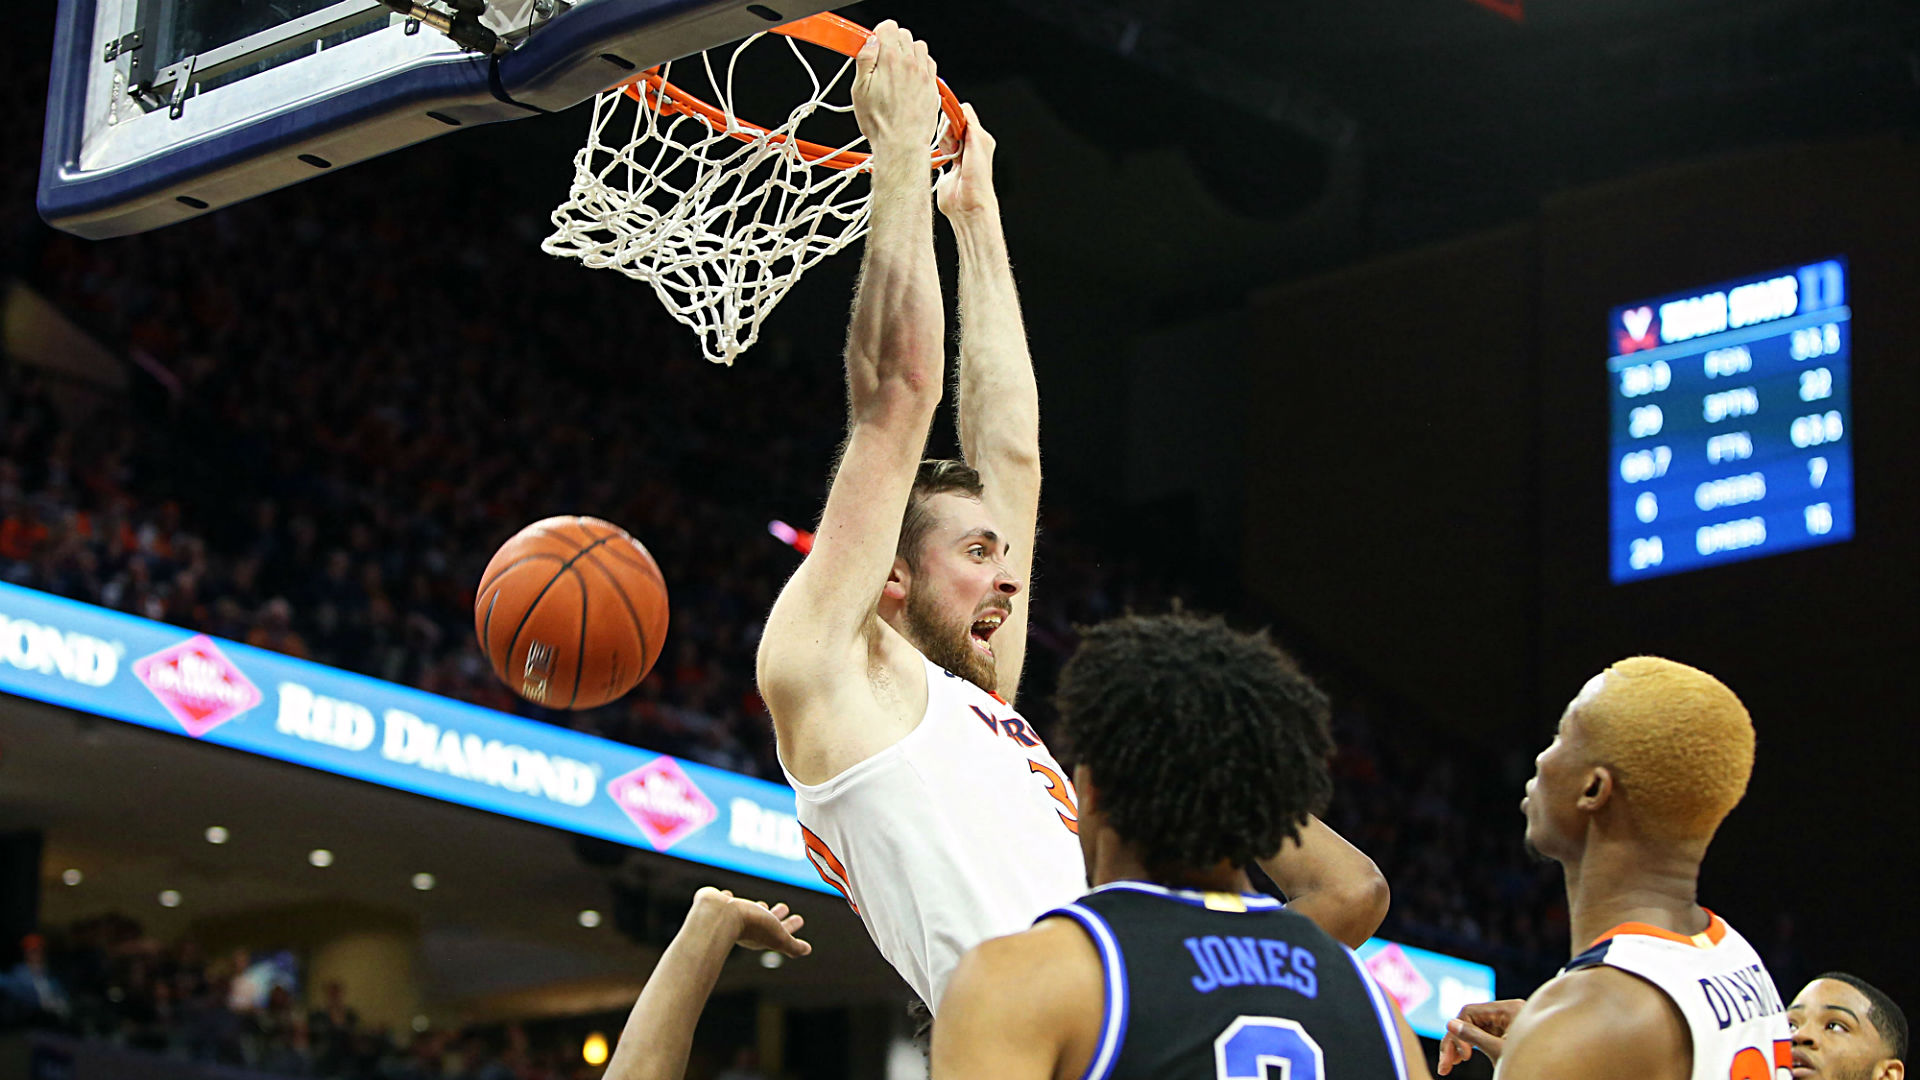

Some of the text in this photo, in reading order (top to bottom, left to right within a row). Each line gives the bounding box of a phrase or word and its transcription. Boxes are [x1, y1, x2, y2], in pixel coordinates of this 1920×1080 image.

[1807, 456, 1828, 489] 7
[0, 613, 118, 687] OND
[277, 681, 375, 751] RED
[381, 708, 598, 807] DIAMOND
[1183, 935, 1318, 999] JONES
